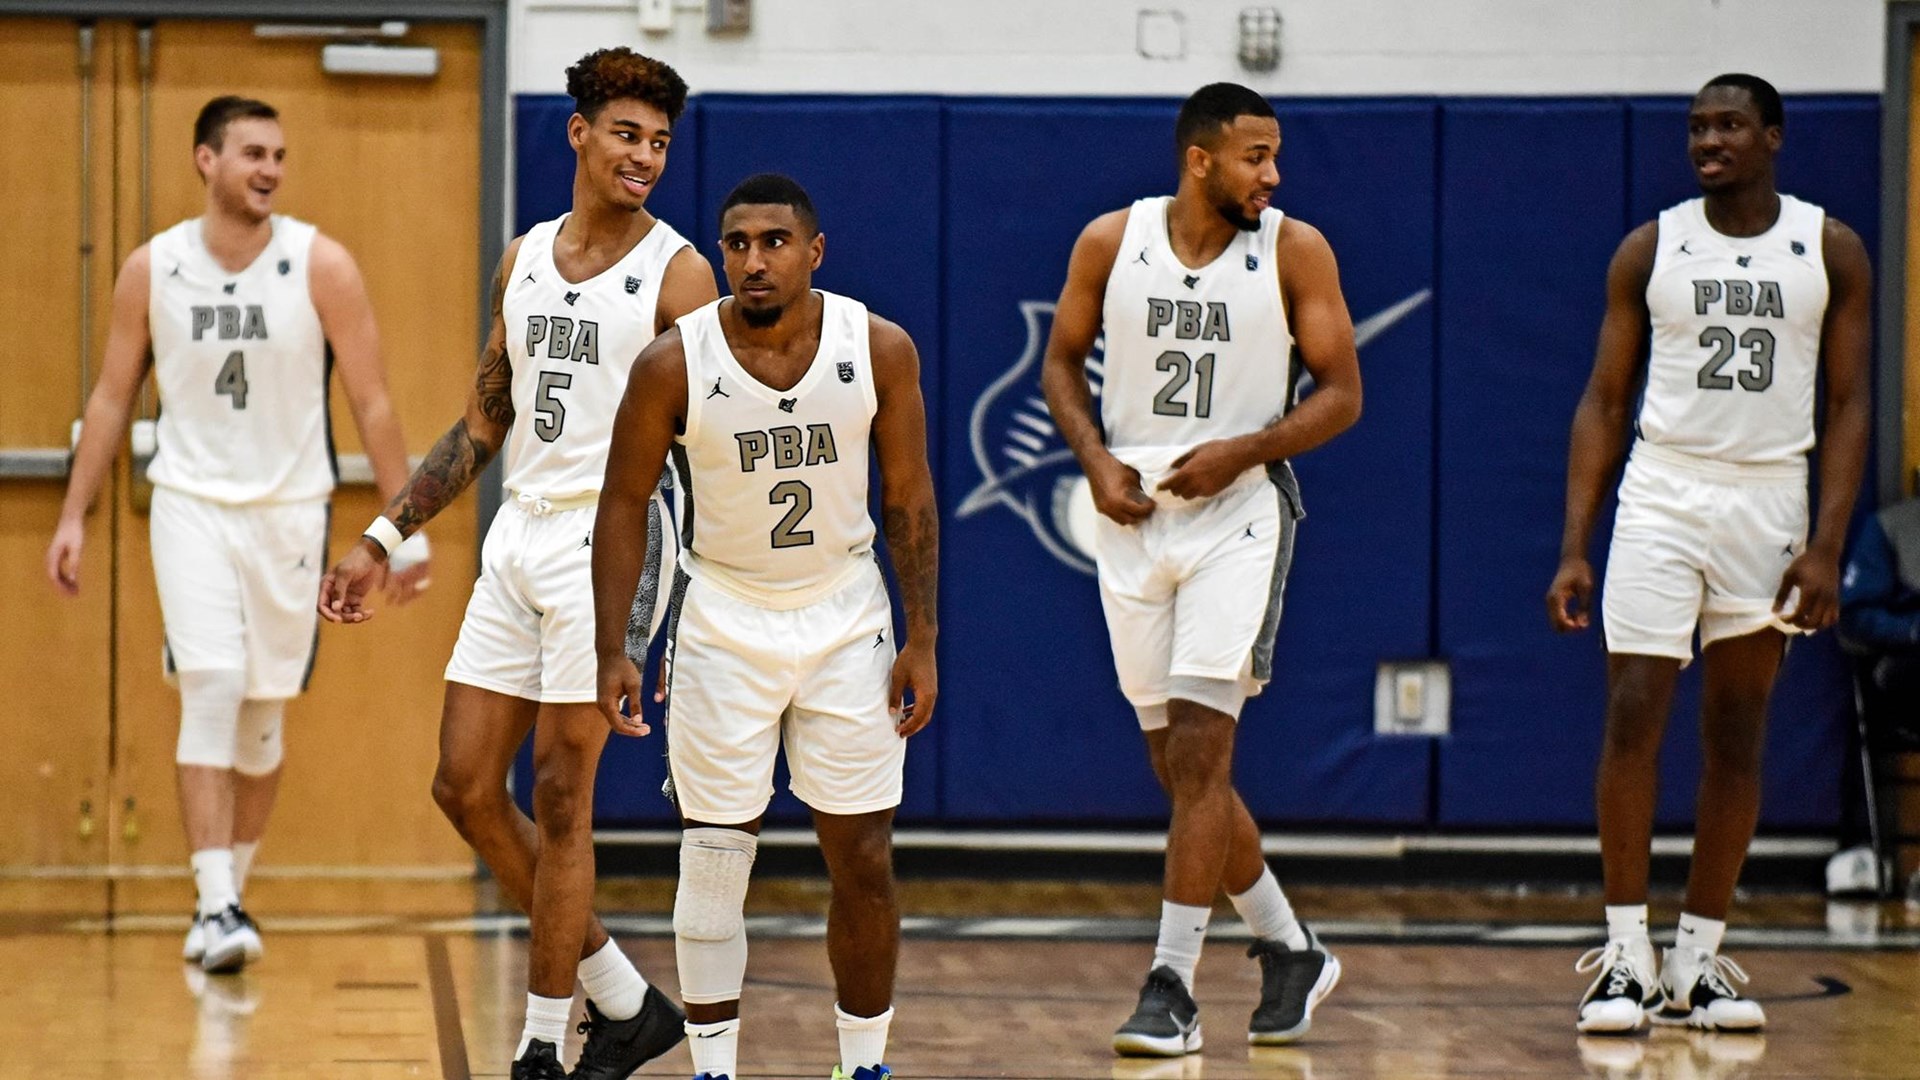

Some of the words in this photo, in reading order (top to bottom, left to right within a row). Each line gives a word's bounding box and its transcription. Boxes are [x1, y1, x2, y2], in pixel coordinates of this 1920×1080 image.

[190, 305, 268, 341] PBA
[1147, 297, 1230, 341] PBA
[1692, 279, 1784, 319] PBA
[526, 315, 599, 365] PBA
[1697, 326, 1776, 393] 23
[214, 350, 248, 410] 4
[534, 370, 572, 443] 5
[1152, 350, 1215, 418] 21
[734, 423, 838, 472] PBA
[769, 480, 814, 549] 2
